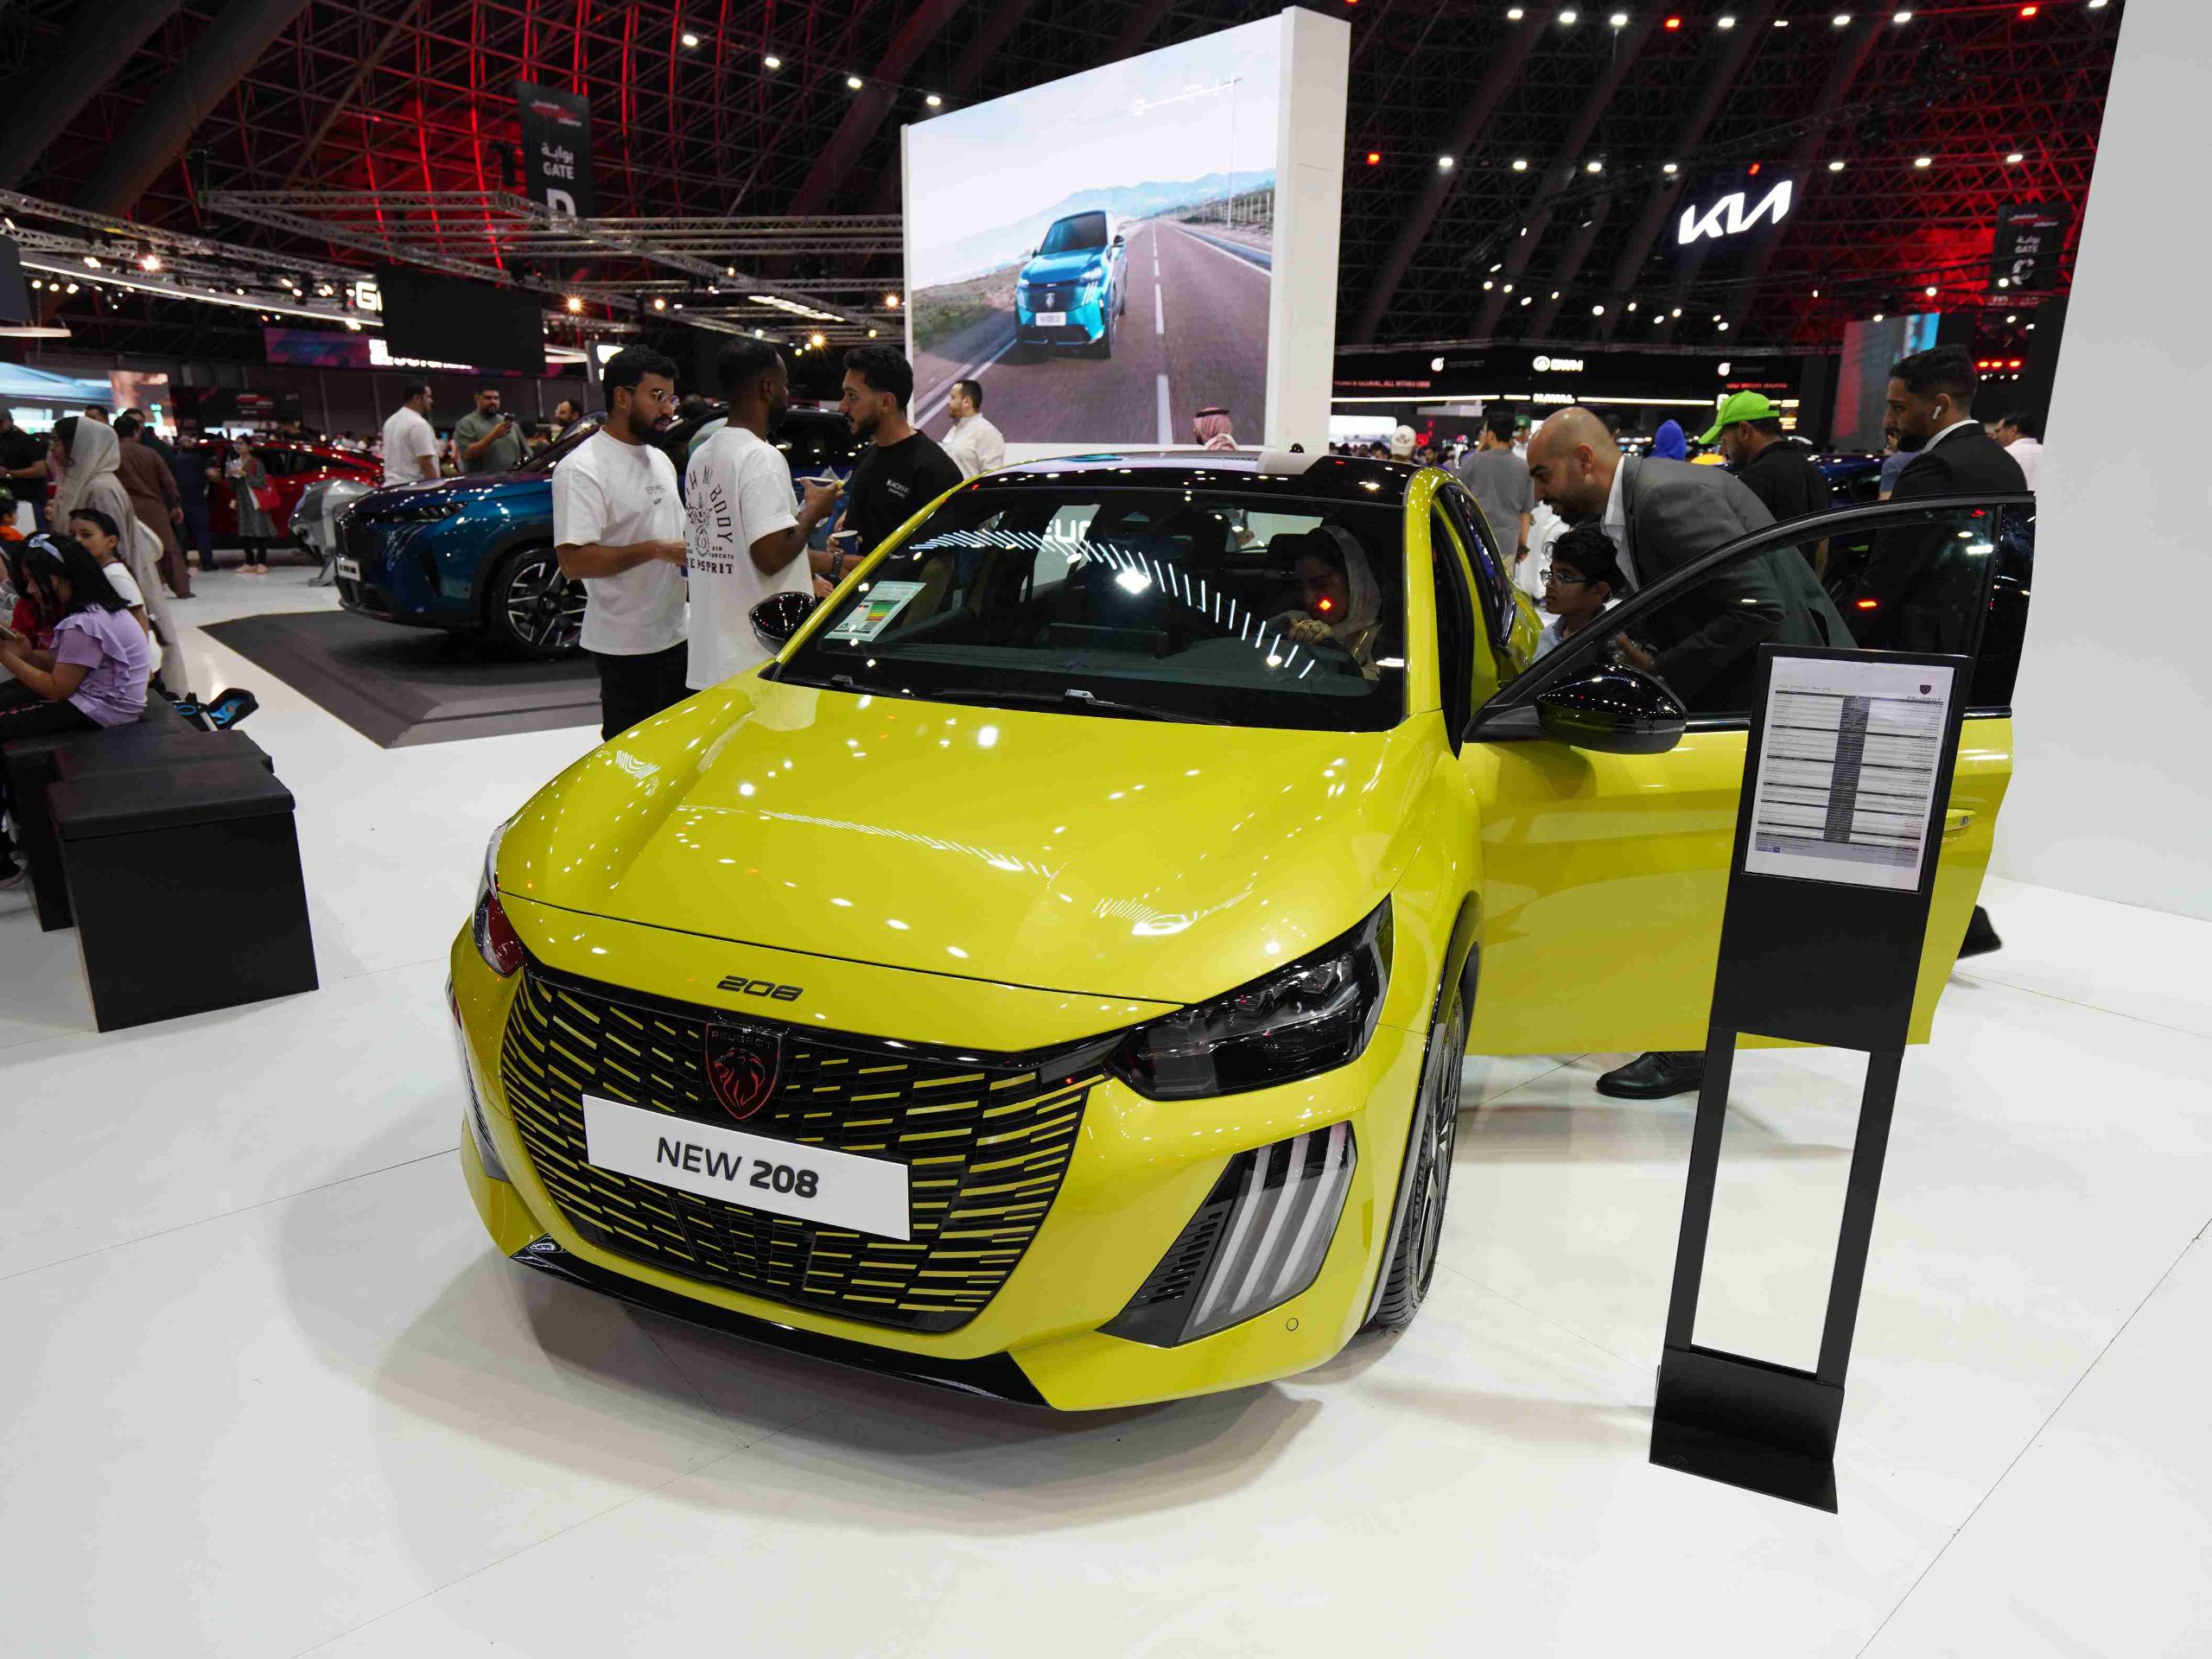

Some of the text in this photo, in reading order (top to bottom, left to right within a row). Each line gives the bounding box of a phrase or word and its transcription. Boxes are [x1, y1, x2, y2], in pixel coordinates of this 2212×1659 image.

[543, 161, 575, 180] GATE
[1678, 180, 1793, 245] KIA
[716, 975, 804, 1001] 208
[711, 1030, 773, 1051] PEUGEOT
[657, 1136, 819, 1198] NEW 208
